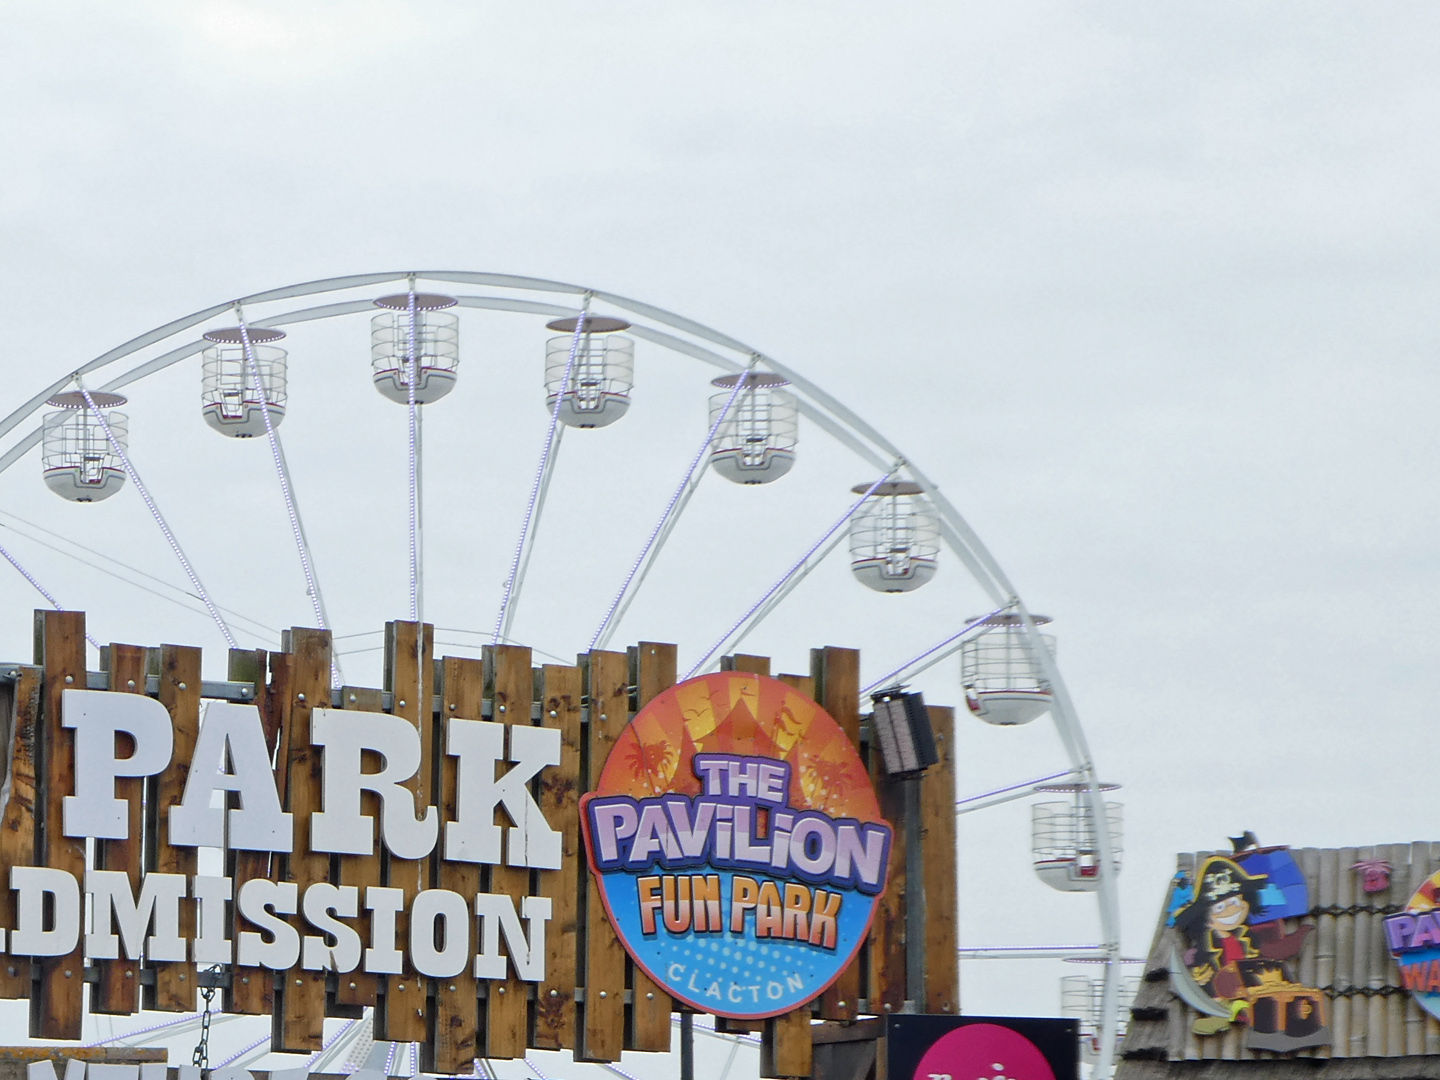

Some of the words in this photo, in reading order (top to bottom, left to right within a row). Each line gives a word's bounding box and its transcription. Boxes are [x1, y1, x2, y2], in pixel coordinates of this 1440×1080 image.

[62, 688, 562, 869] PARK
[699, 760, 786, 802] THE
[637, 875, 721, 934] FUN
[731, 876, 842, 949] PARK
[668, 964, 804, 1003] CLACTON
